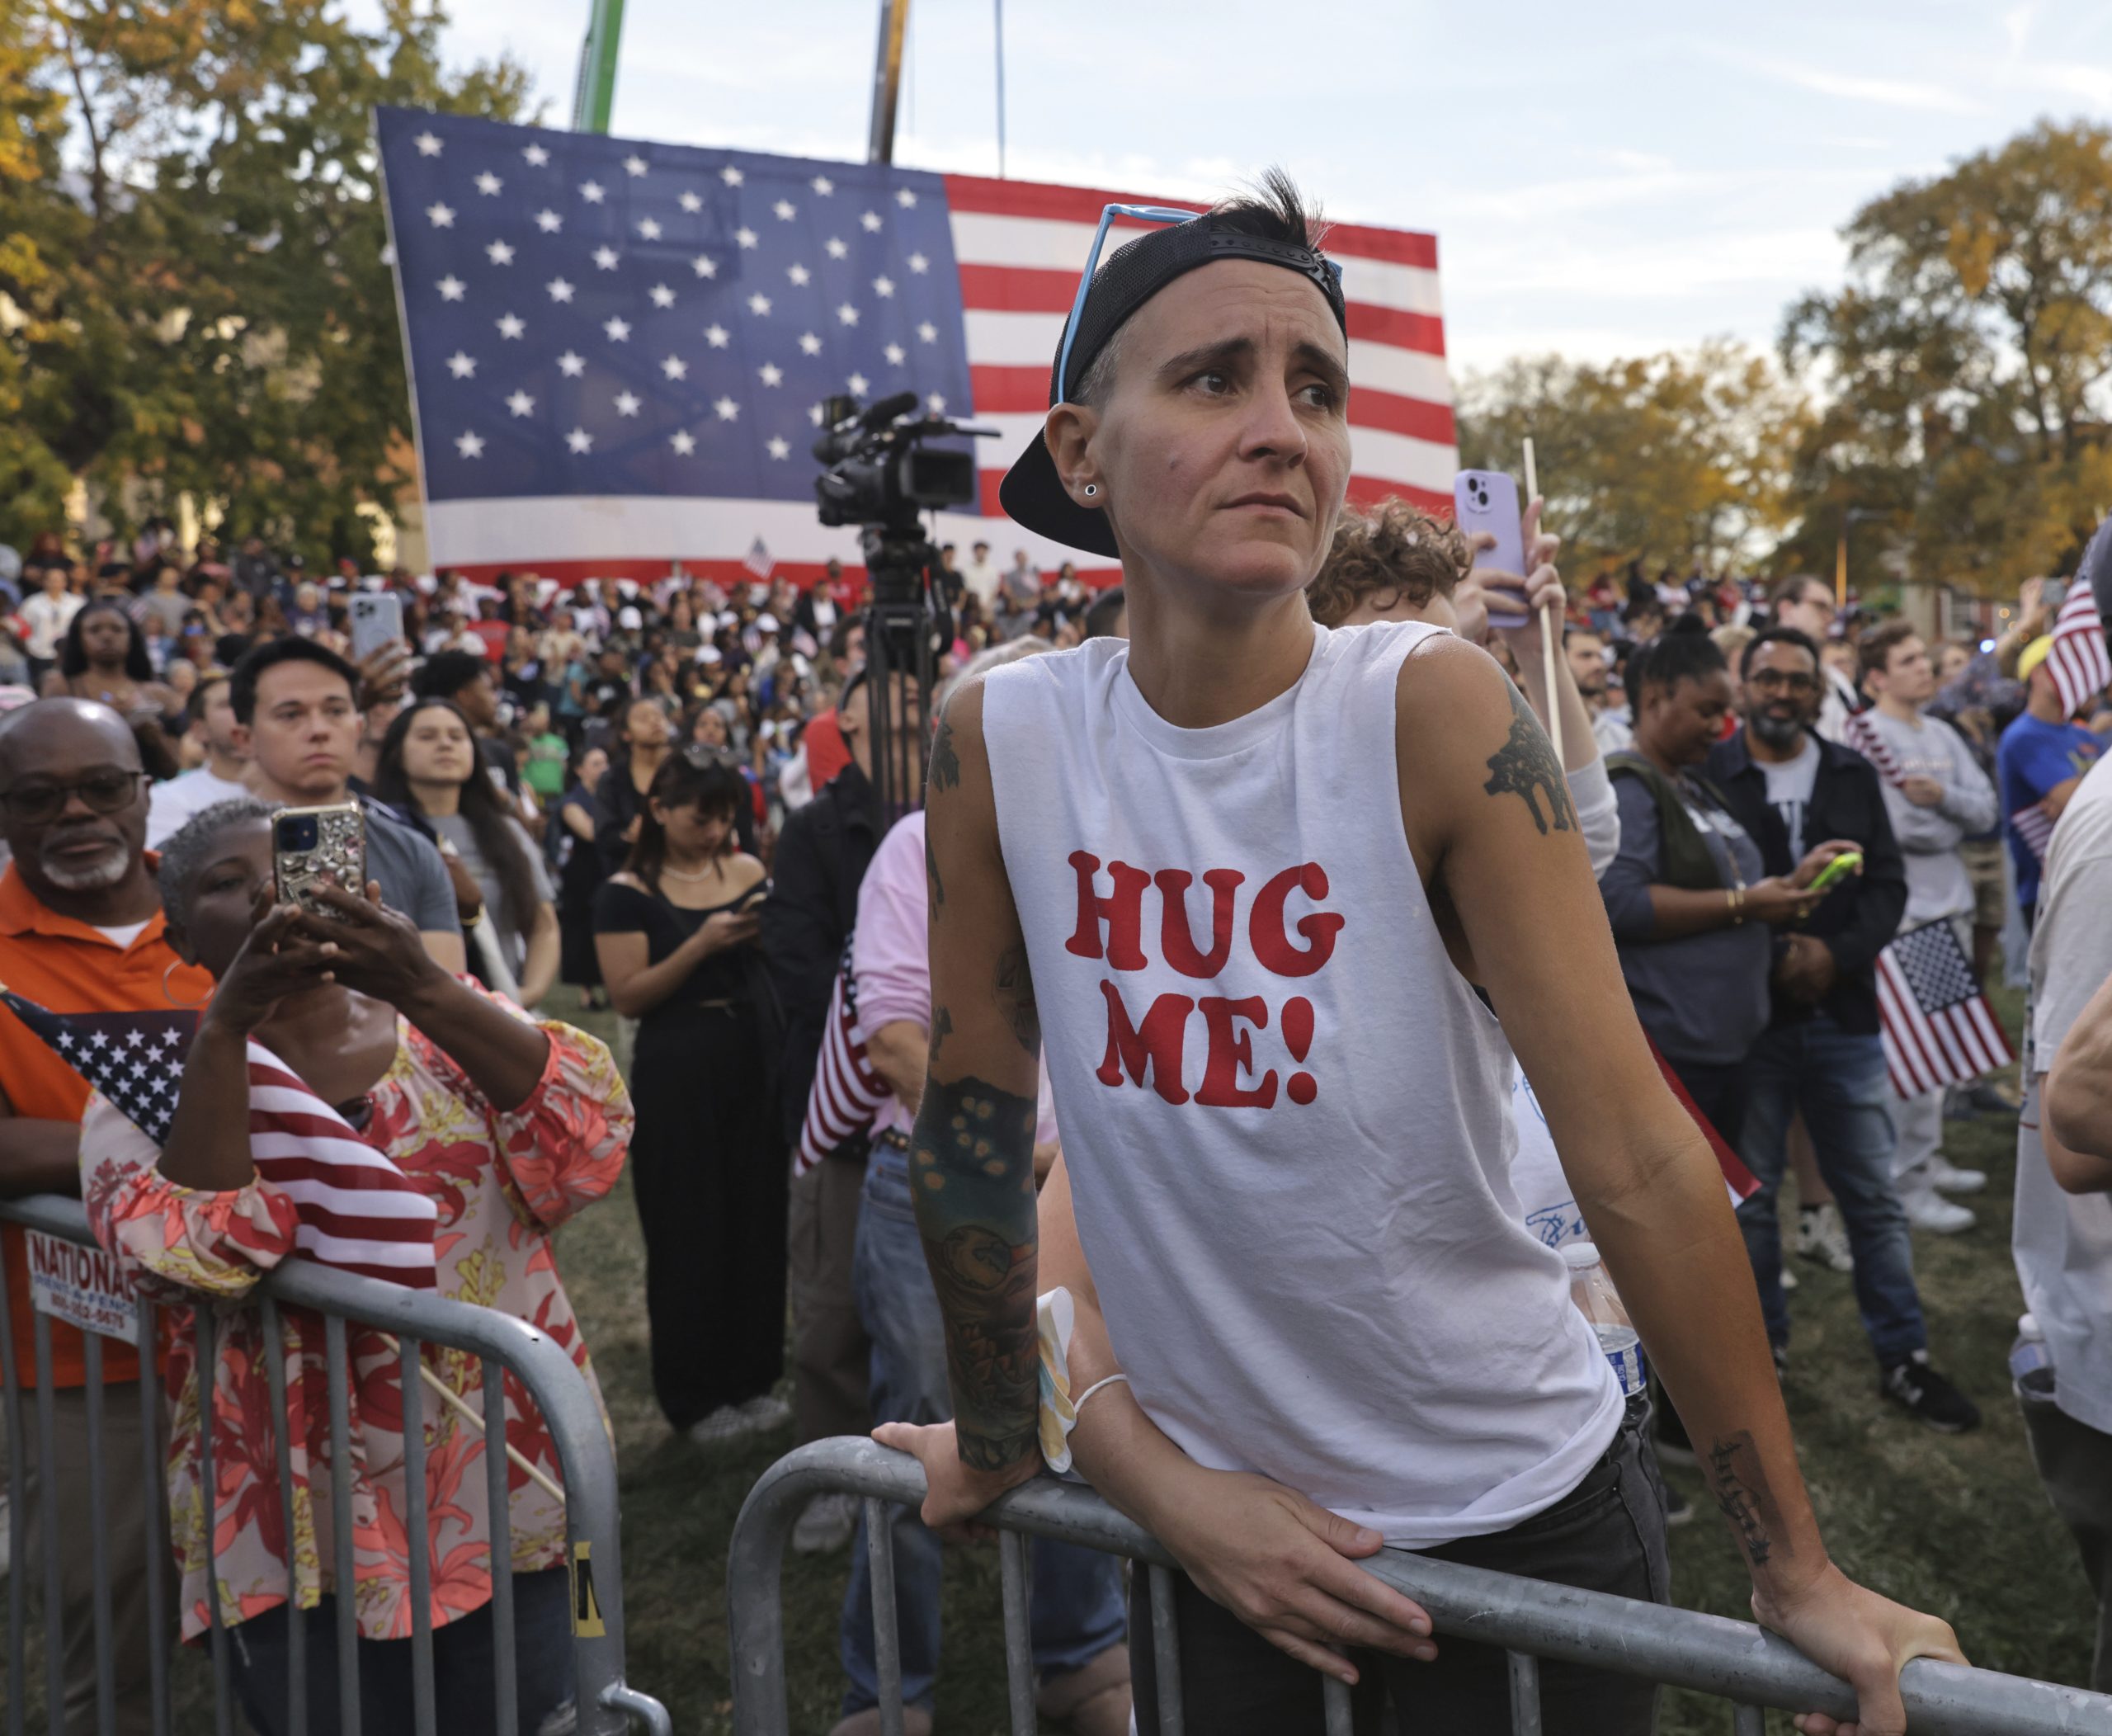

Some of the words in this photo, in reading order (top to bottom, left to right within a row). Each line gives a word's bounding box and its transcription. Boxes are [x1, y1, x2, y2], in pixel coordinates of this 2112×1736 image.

[1065, 850, 1346, 979] HUG
[1096, 979, 1318, 1110] ME!
[31, 1233, 135, 1304] NATIONAL
